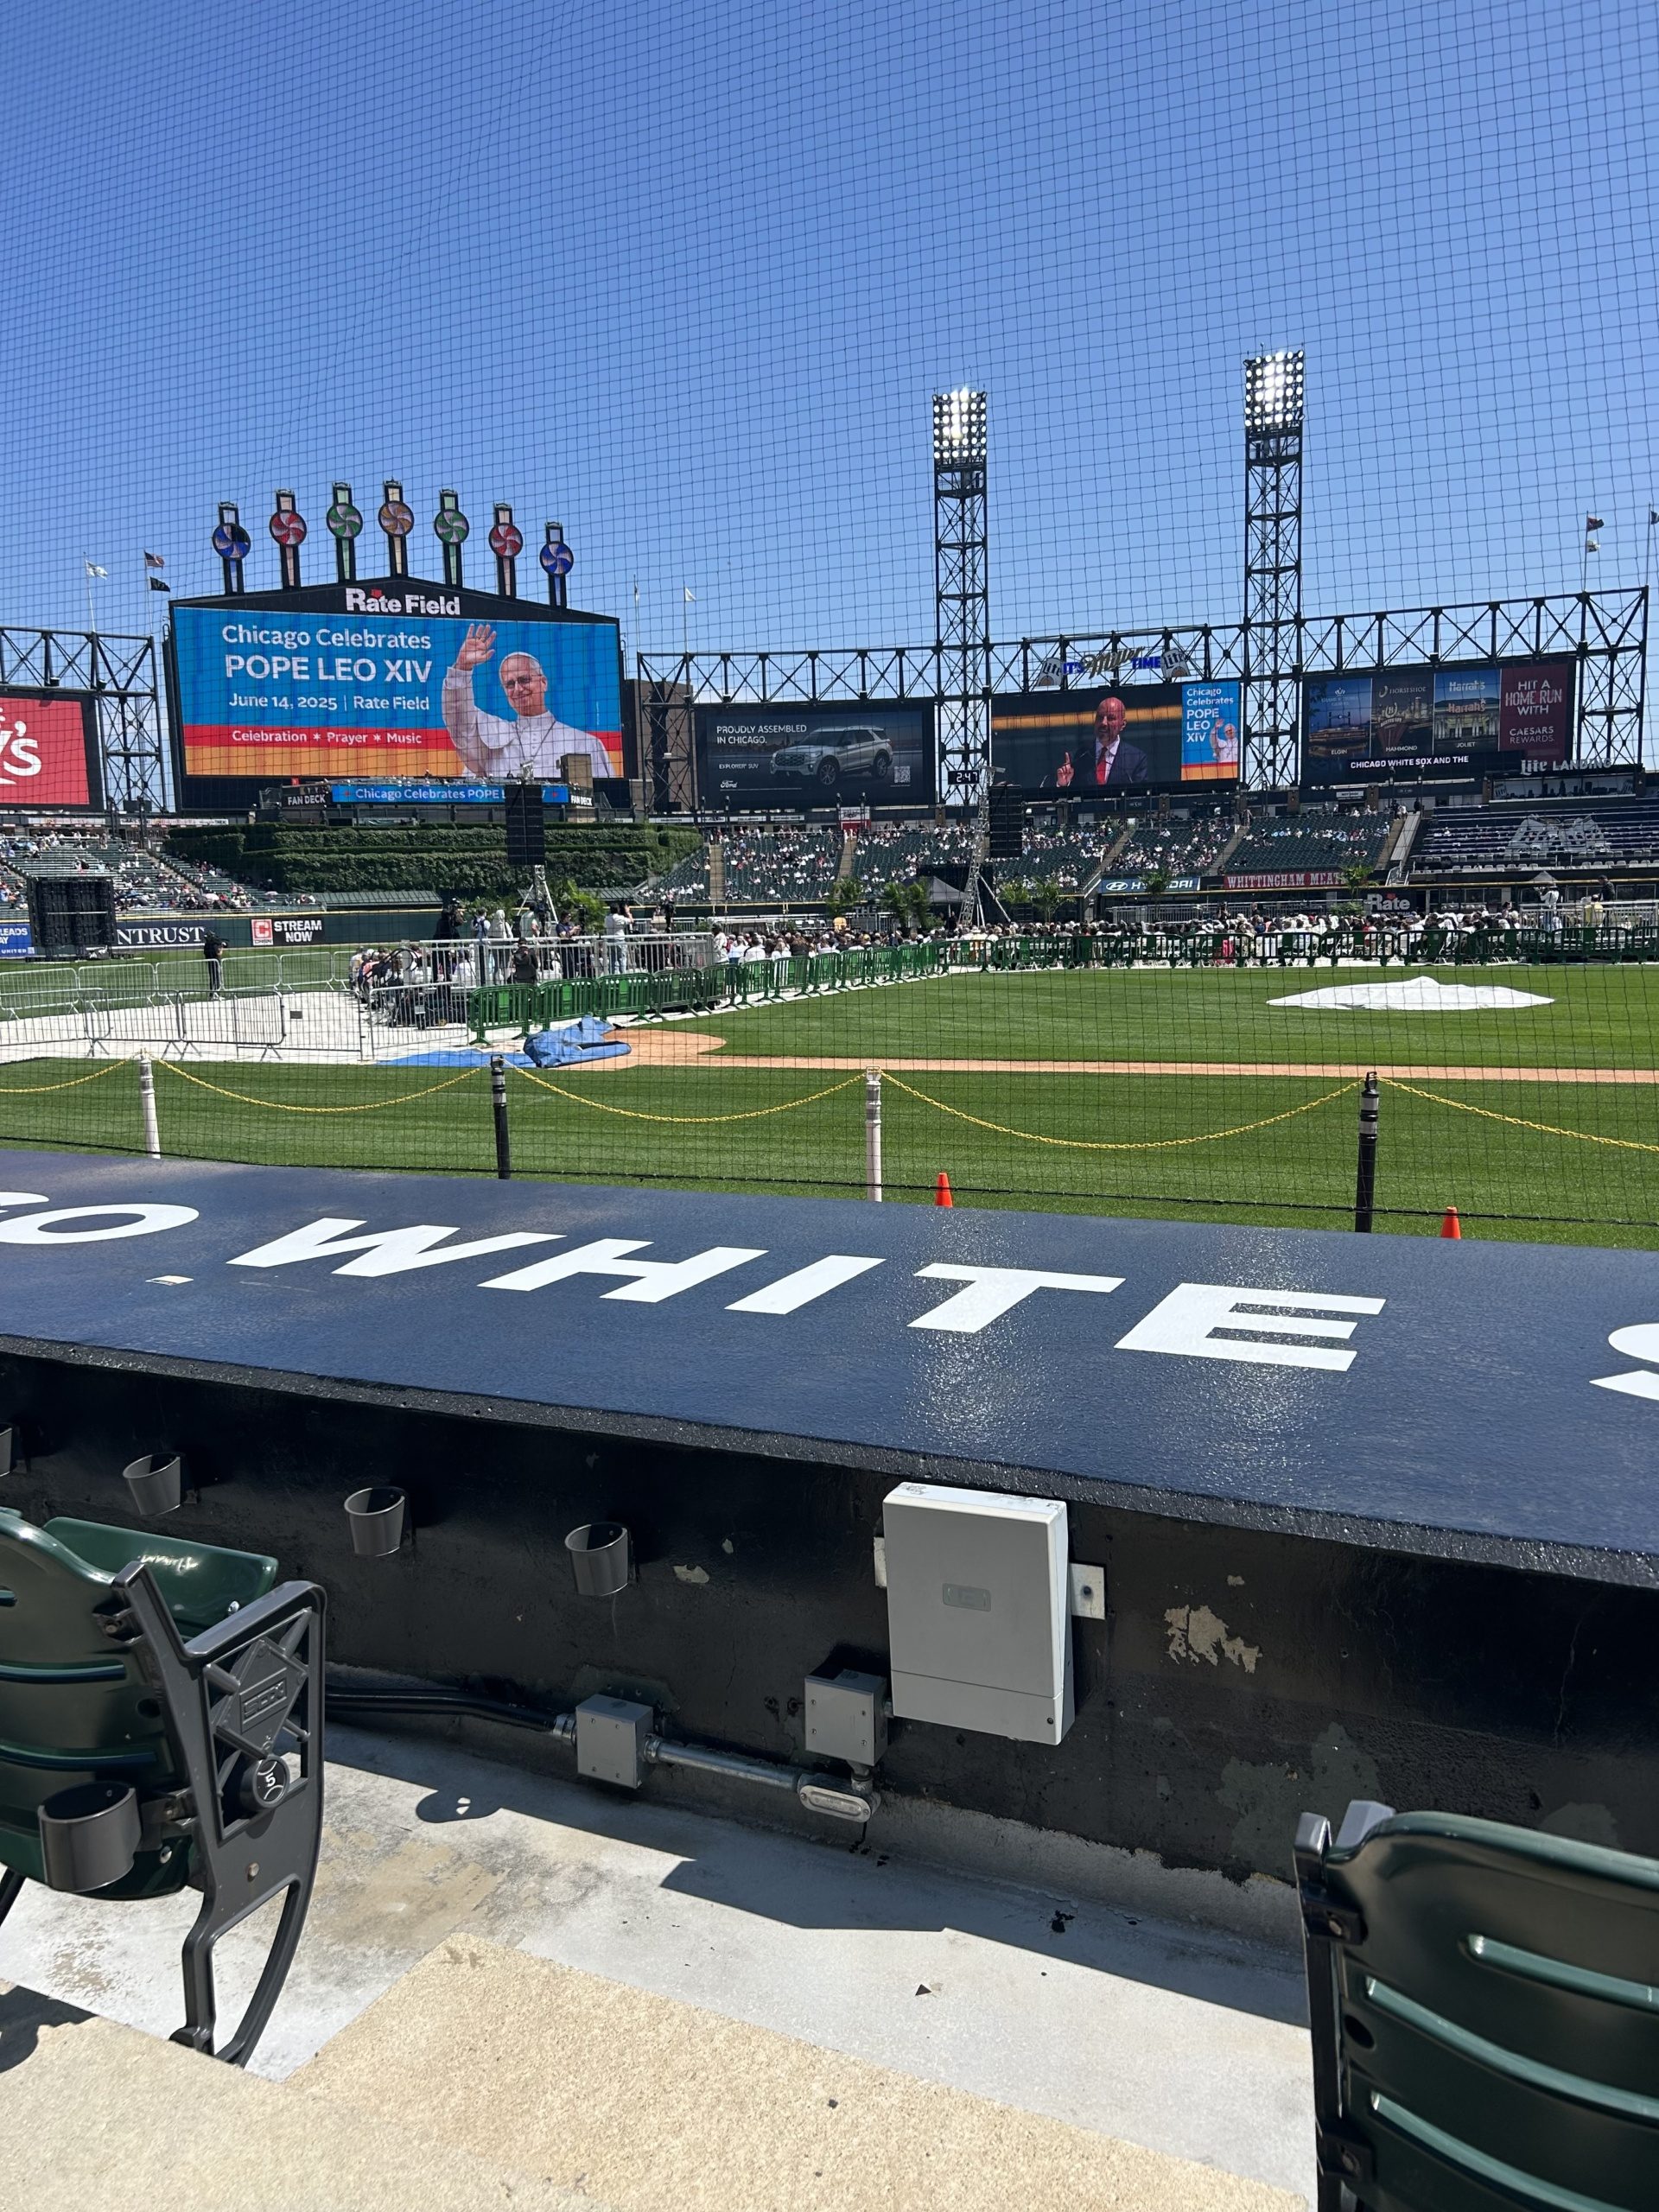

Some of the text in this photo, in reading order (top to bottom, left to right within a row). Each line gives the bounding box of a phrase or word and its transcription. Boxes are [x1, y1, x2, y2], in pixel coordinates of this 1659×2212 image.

[346, 588, 461, 615] Rate Field
[221, 625, 432, 650] Chicago Celebrates
[225, 654, 433, 683] POPE LEO XIV
[1080, 646, 1146, 679] Miller
[1132, 656, 1161, 670] TIME
[1518, 679, 1551, 690] HIT A
[1186, 688, 1222, 696] Chicago
[1505, 689, 1562, 707] HOME RUN
[229, 693, 430, 710] June 14, 2025 Rate Field
[1186, 697, 1234, 706] Celebrates
[1186, 708, 1219, 719] POPE
[1516, 704, 1549, 716] WITH
[716, 724, 807, 734] PROUDLY ASSEMBLED
[1186, 720, 1211, 731] LEO
[1510, 726, 1554, 736] CAESARS
[232, 730, 423, 746] Celebration Prayer Music
[728, 735, 767, 744] CHICAGO.
[1185, 732, 1207, 742] XIV
[1351, 760, 1387, 769] CHICAGO
[1387, 758, 1414, 767] WHITE
[1415, 757, 1433, 766] SOX
[1521, 758, 1612, 776] Lite LANDING
[720, 779, 739, 788] Ford
[288, 794, 326, 806] FAN DECK
[355, 788, 403, 802] Chicago
[404, 787, 465, 799] Celebrates
[467, 789, 499, 799] POPE
[570, 795, 593, 806] FAN DECK
[1227, 874, 1306, 889] WHITTINGHAM
[1365, 893, 1410, 911] Rate
[0, 927, 29, 936] LEADS
[273, 919, 322, 932] STREAM
[116, 926, 206, 945] NTRUST
[285, 931, 313, 942] NOW
[226, 1217, 1387, 1372] WHITE
[264, 1772, 276, 1788] 5
